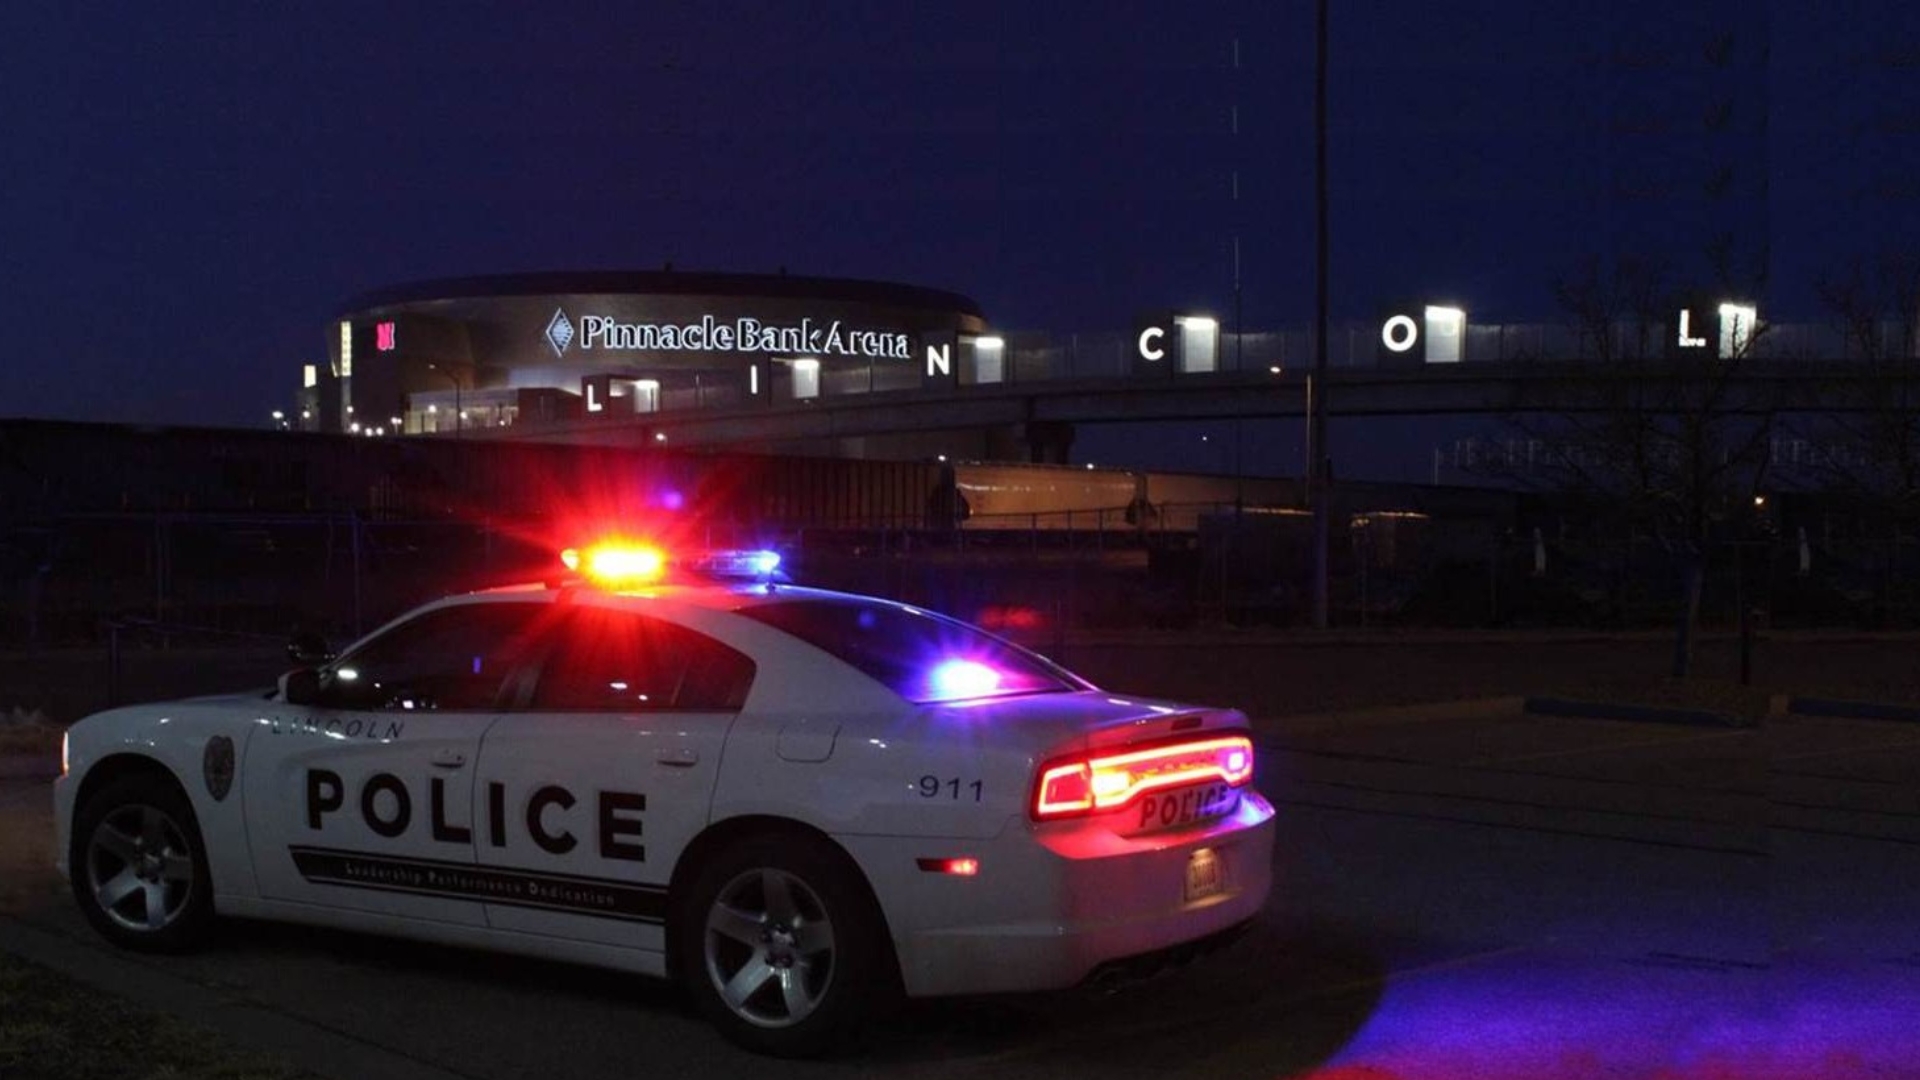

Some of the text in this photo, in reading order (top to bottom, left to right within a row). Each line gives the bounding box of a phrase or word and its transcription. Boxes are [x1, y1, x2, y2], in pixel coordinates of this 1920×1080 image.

[580, 315, 911, 359] Pinnacle Bank Arena
[920, 775, 982, 801] 911
[1139, 785, 1228, 828] POLICE
[308, 769, 646, 862] POLICE
[529, 881, 615, 906] Dedication
